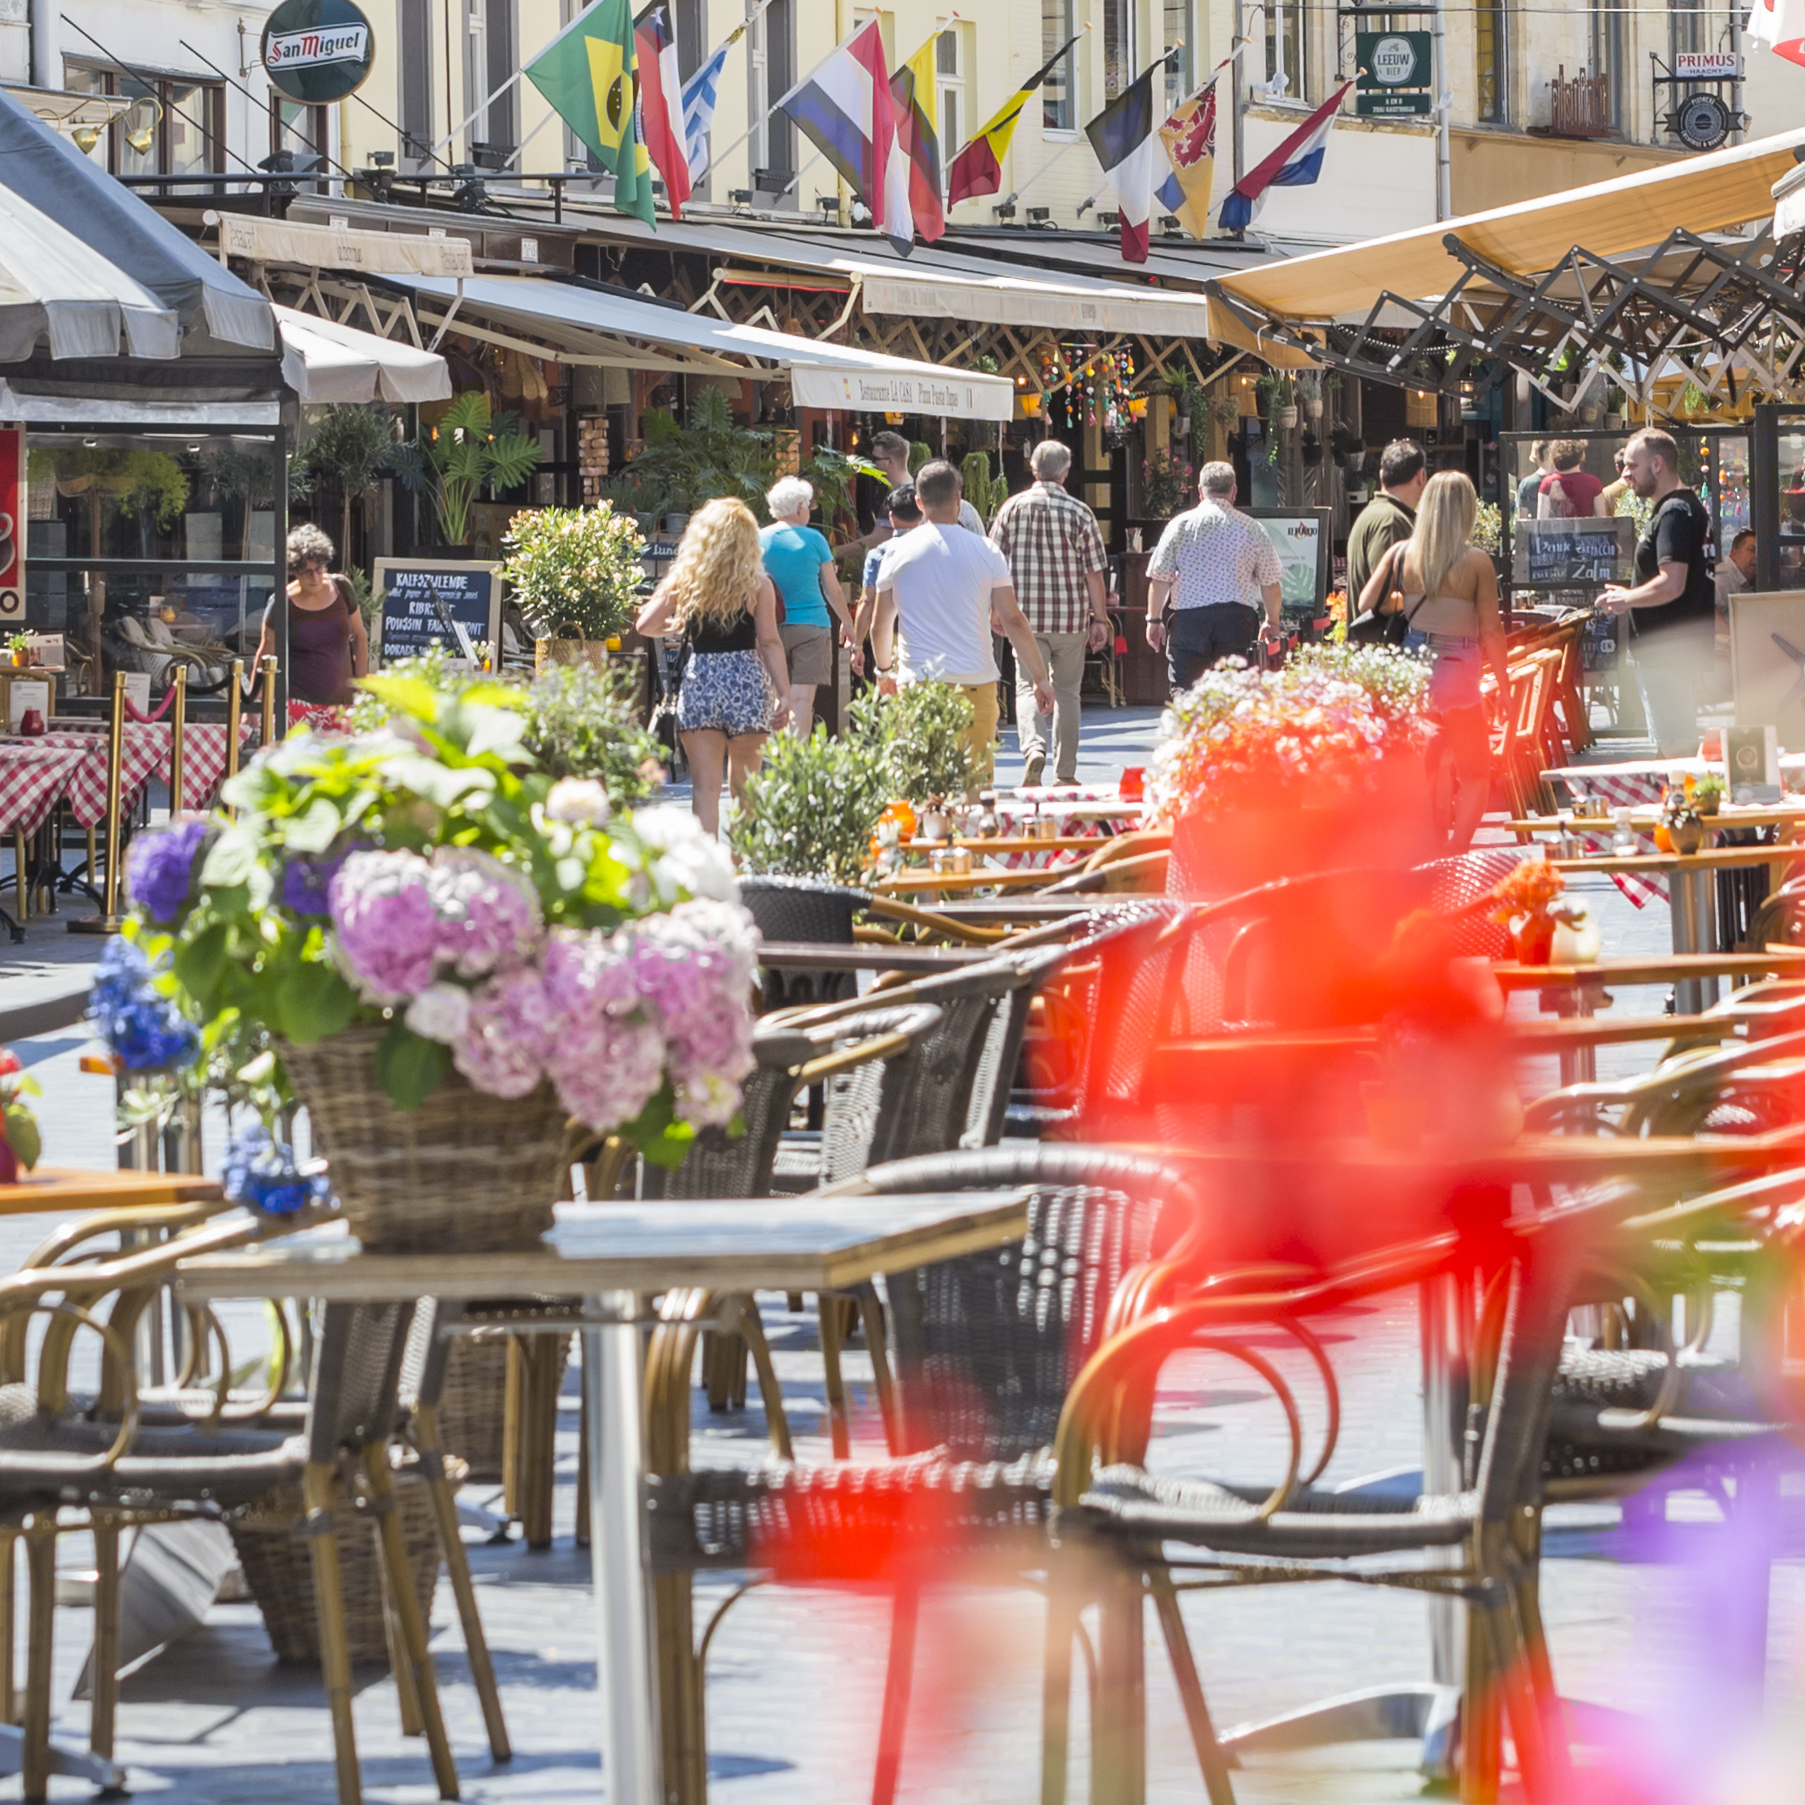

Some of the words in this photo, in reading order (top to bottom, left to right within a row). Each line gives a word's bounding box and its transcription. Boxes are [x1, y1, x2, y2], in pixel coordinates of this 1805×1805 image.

[1378, 54, 1409, 65] LEEUW
[1678, 55, 1735, 68] PRIMUS
[385, 616, 422, 631] POUSSIN
